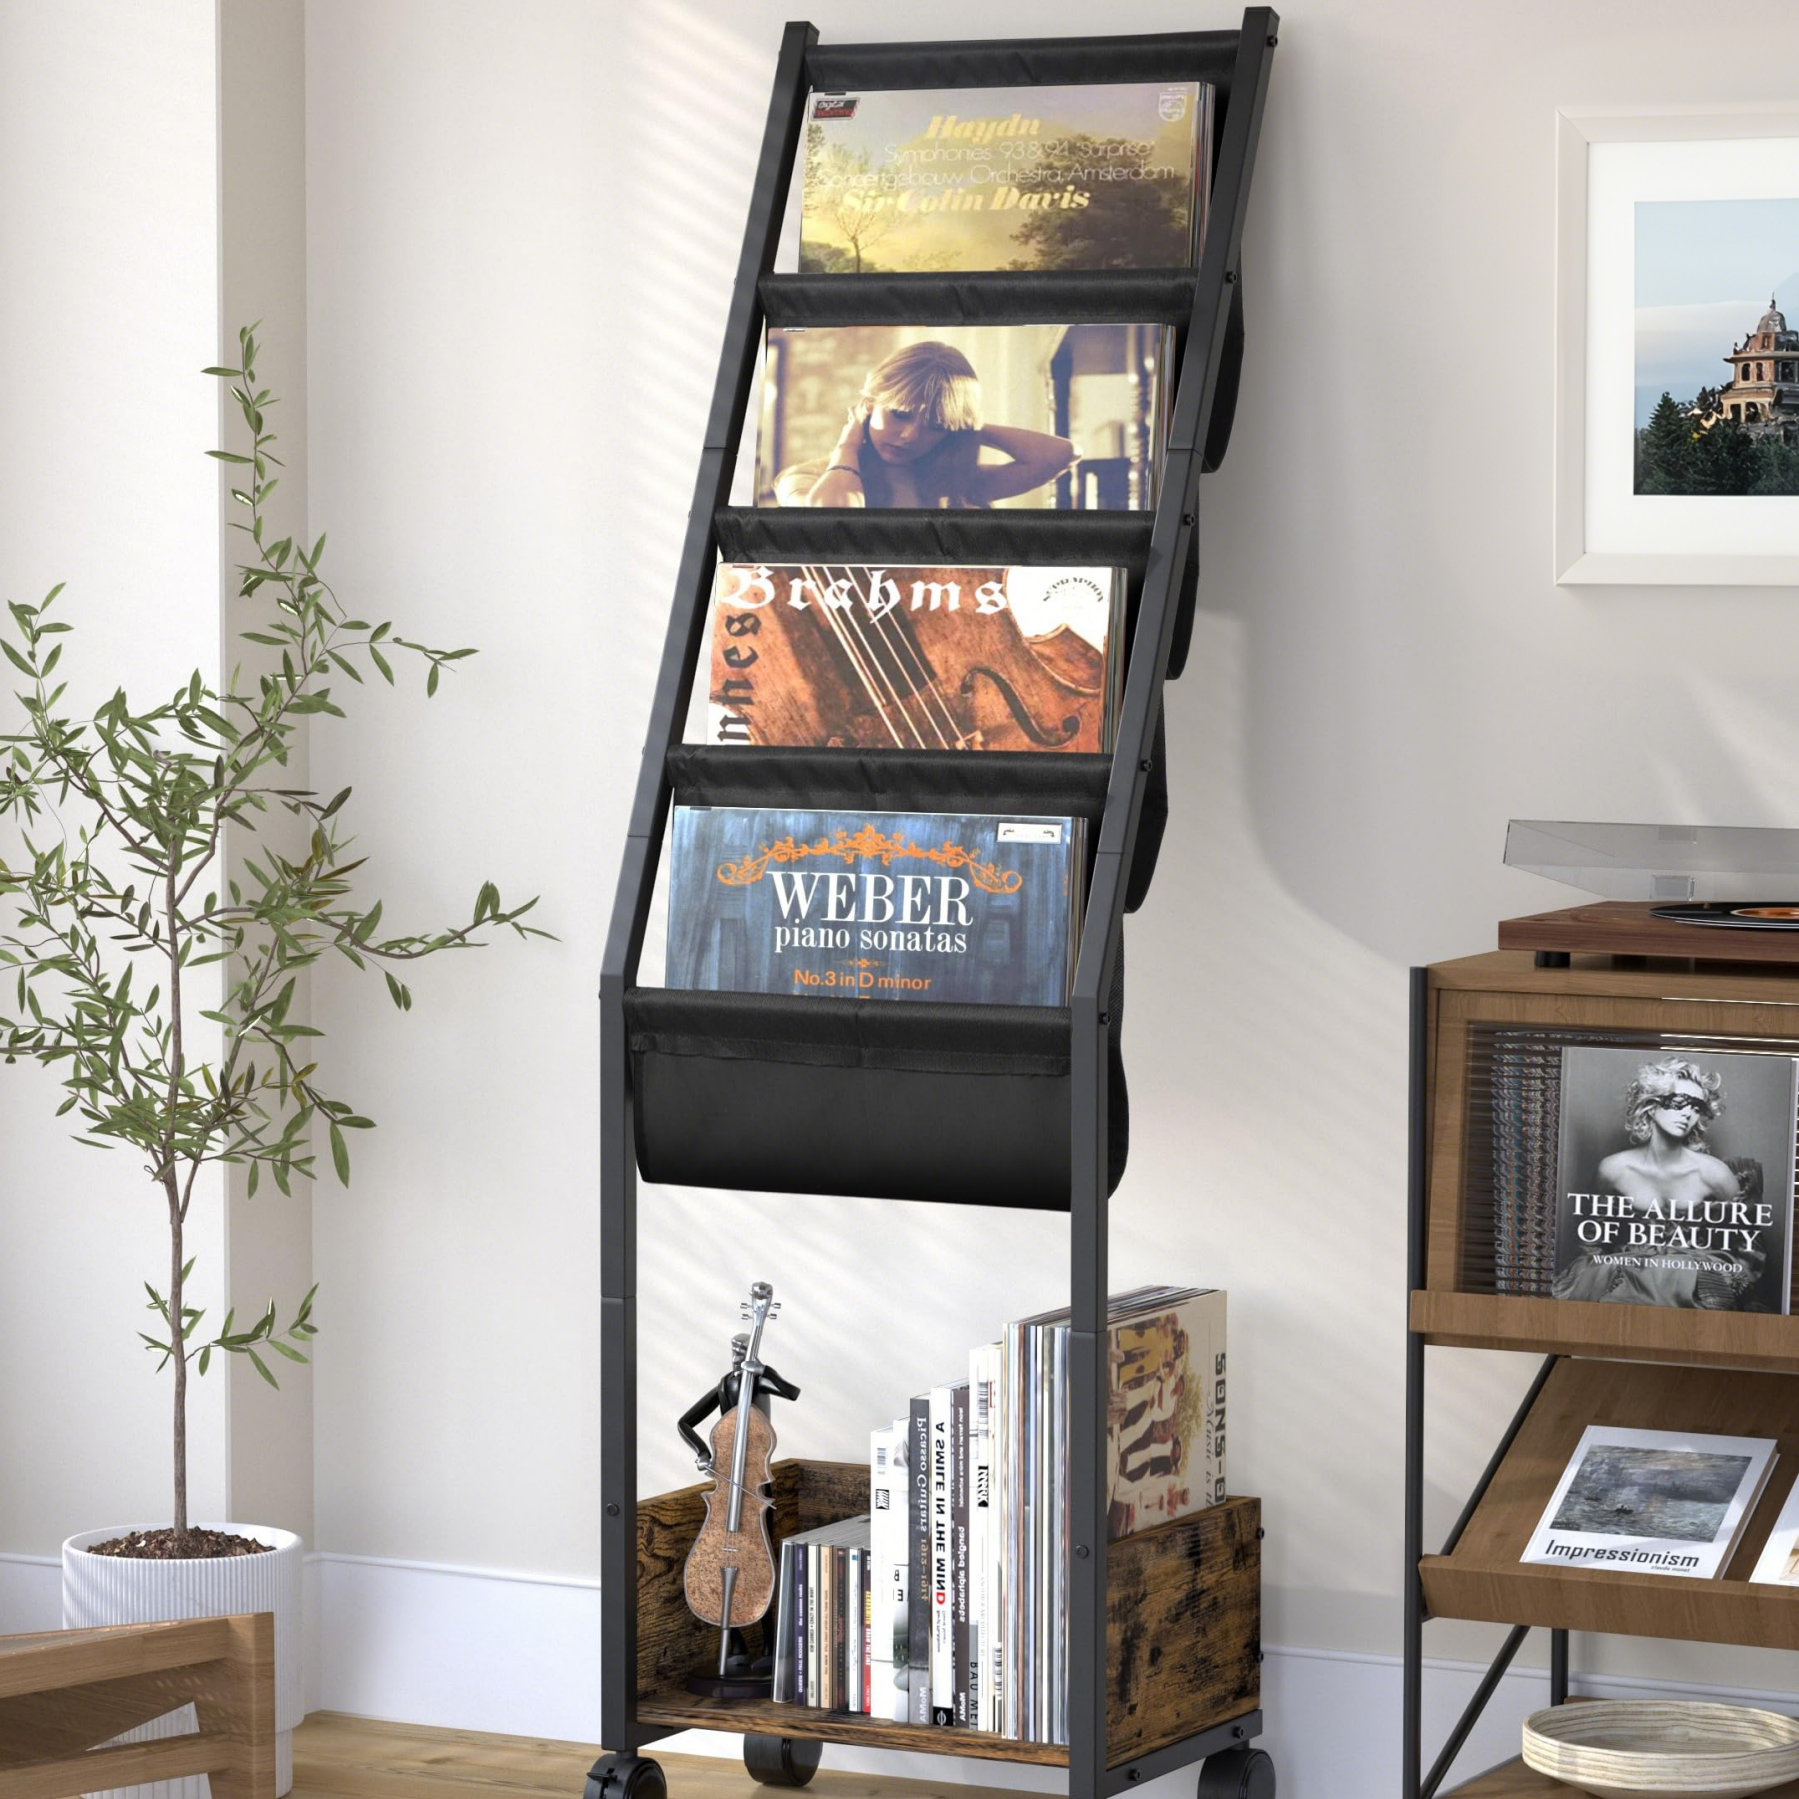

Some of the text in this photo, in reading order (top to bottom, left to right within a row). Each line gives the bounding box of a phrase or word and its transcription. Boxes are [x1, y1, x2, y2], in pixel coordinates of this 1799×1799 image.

[926, 113, 1040, 145] Haydn
[885, 141, 992, 165] Symphonies
[1067, 160, 1175, 182] Amsterdam
[842, 185, 1091, 212] Sir Colin Davis
[720, 566, 1009, 624] Brahms
[766, 871, 974, 927] WEBER
[774, 918, 968, 953] piano sonatas
[839, 972, 855, 987] in
[858, 972, 874, 988] D
[877, 974, 931, 990] minor
[1567, 1192, 1774, 1227] THE ALLURE
[1577, 1219, 1762, 1251] OF BEAUTY
[1593, 1255, 1743, 1274] WOMEN IN HOLLYWOOD
[1545, 1539, 1700, 1567] Impressionism
